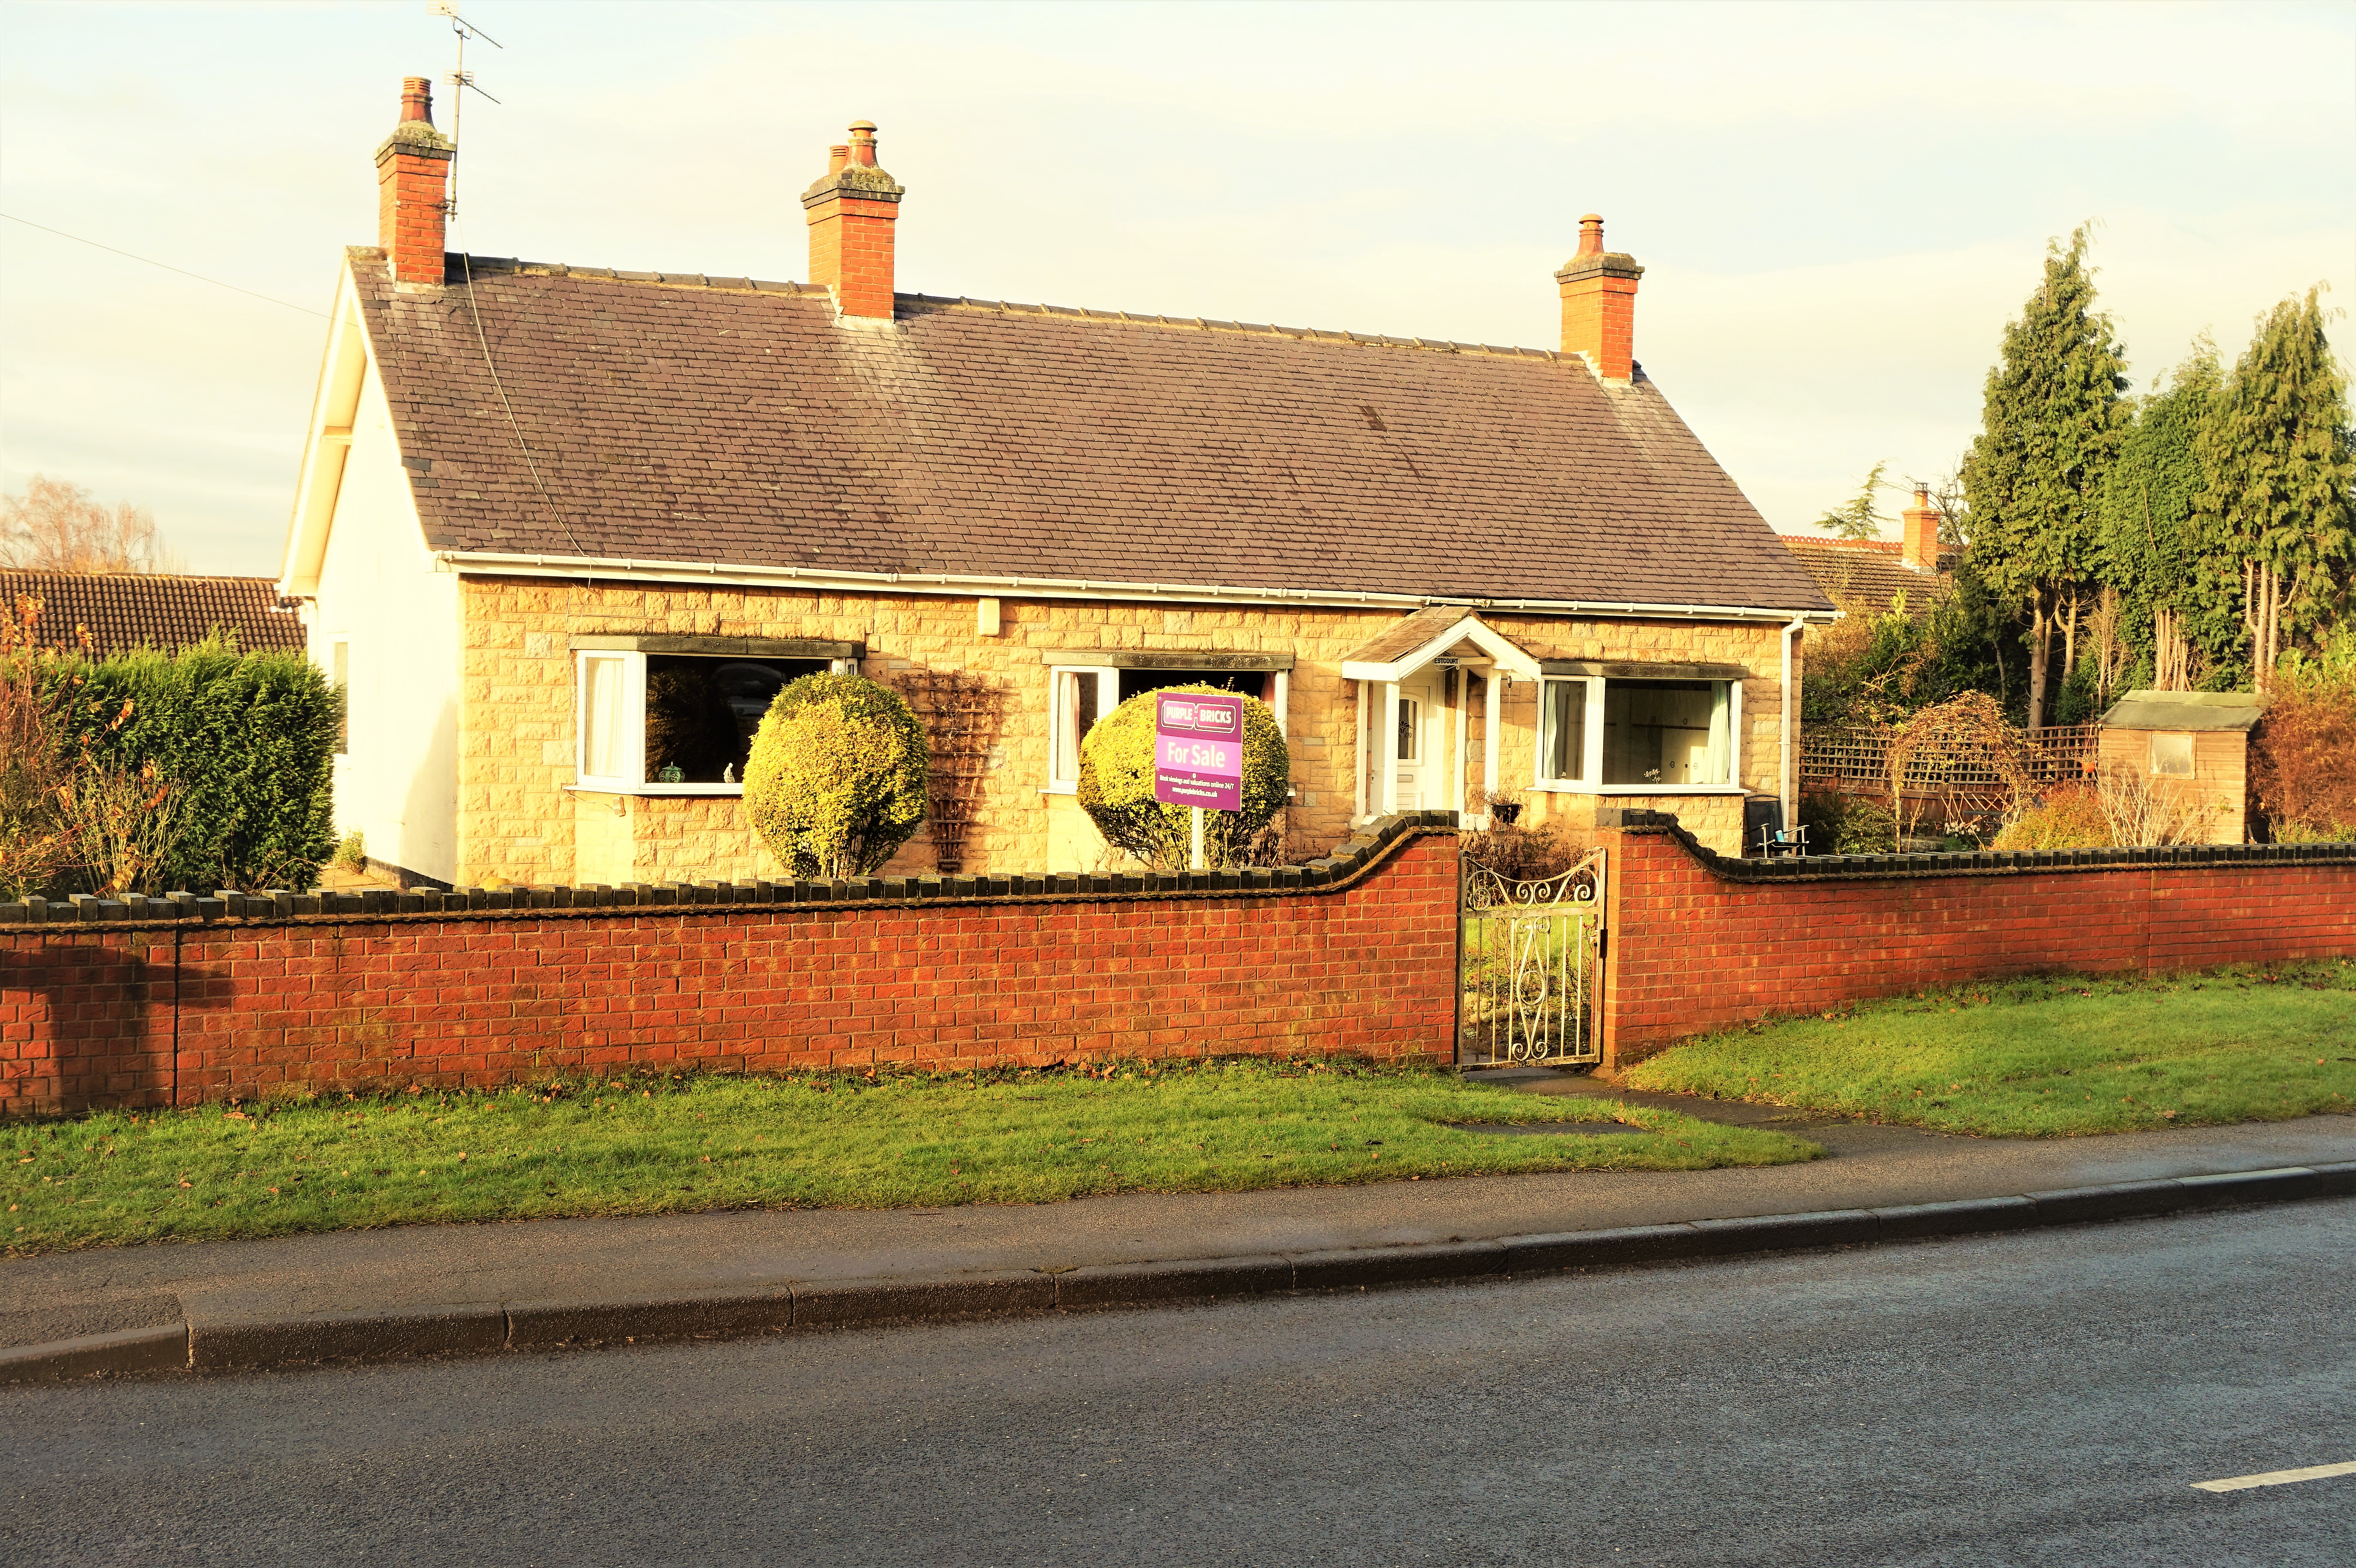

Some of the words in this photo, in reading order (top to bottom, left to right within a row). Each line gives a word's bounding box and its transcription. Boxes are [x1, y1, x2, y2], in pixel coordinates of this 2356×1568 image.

[1166, 706, 1193, 721] PURPLE
[1200, 709, 1232, 724] BRICKS
[1168, 742, 1189, 764] For
[1191, 744, 1225, 768] Sale
[1168, 775, 1183, 785] viewings
[1190, 779, 1210, 787] valuations
[1172, 787, 1218, 798] www.purplebricks.co.uk
